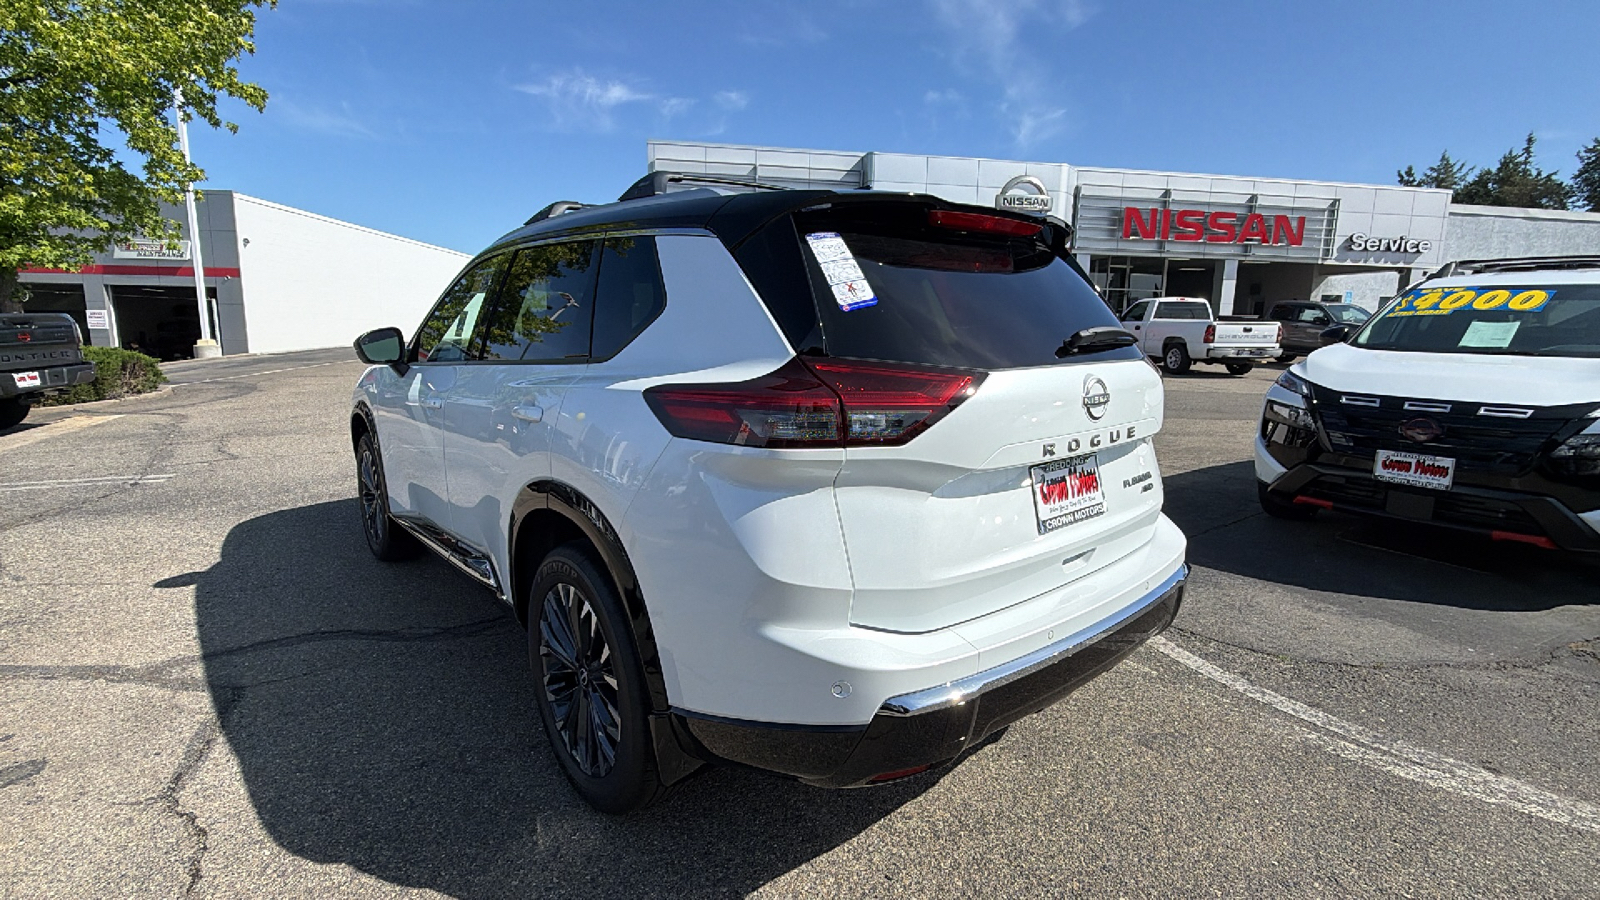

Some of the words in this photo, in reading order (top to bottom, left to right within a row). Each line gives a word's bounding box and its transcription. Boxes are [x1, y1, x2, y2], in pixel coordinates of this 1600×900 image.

[1002, 197, 1049, 207] NISSAN
[1122, 206, 1306, 247] NISSAN
[1350, 232, 1432, 253] Service
[1394, 290, 1548, 311] $4000
[1042, 426, 1136, 457] ROGUE
[1049, 457, 1085, 472] REDDING
[1046, 511, 1074, 530] CROWN
[1074, 503, 1105, 521] MOTORS
[542, 561, 578, 577] DUNLOP
